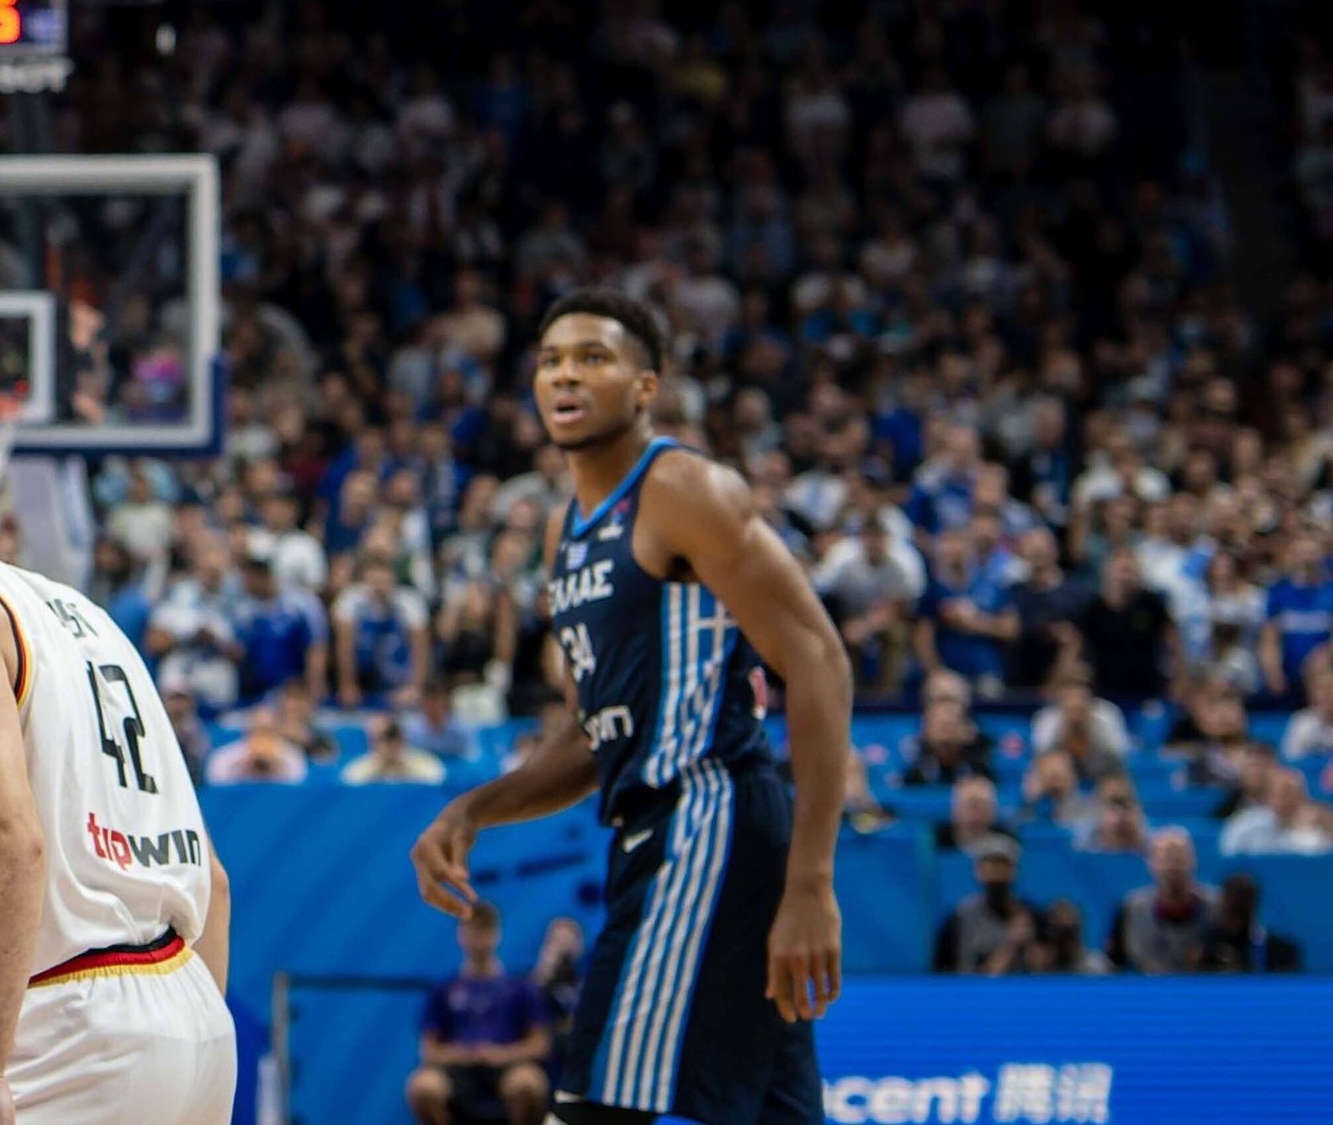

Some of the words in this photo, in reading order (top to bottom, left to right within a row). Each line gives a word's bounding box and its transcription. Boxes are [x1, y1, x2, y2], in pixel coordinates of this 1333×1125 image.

[560, 622, 597, 683] 34
[86, 661, 159, 795] 42
[86, 812, 202, 870] tipwin
[822, 1071, 990, 1124] cent
